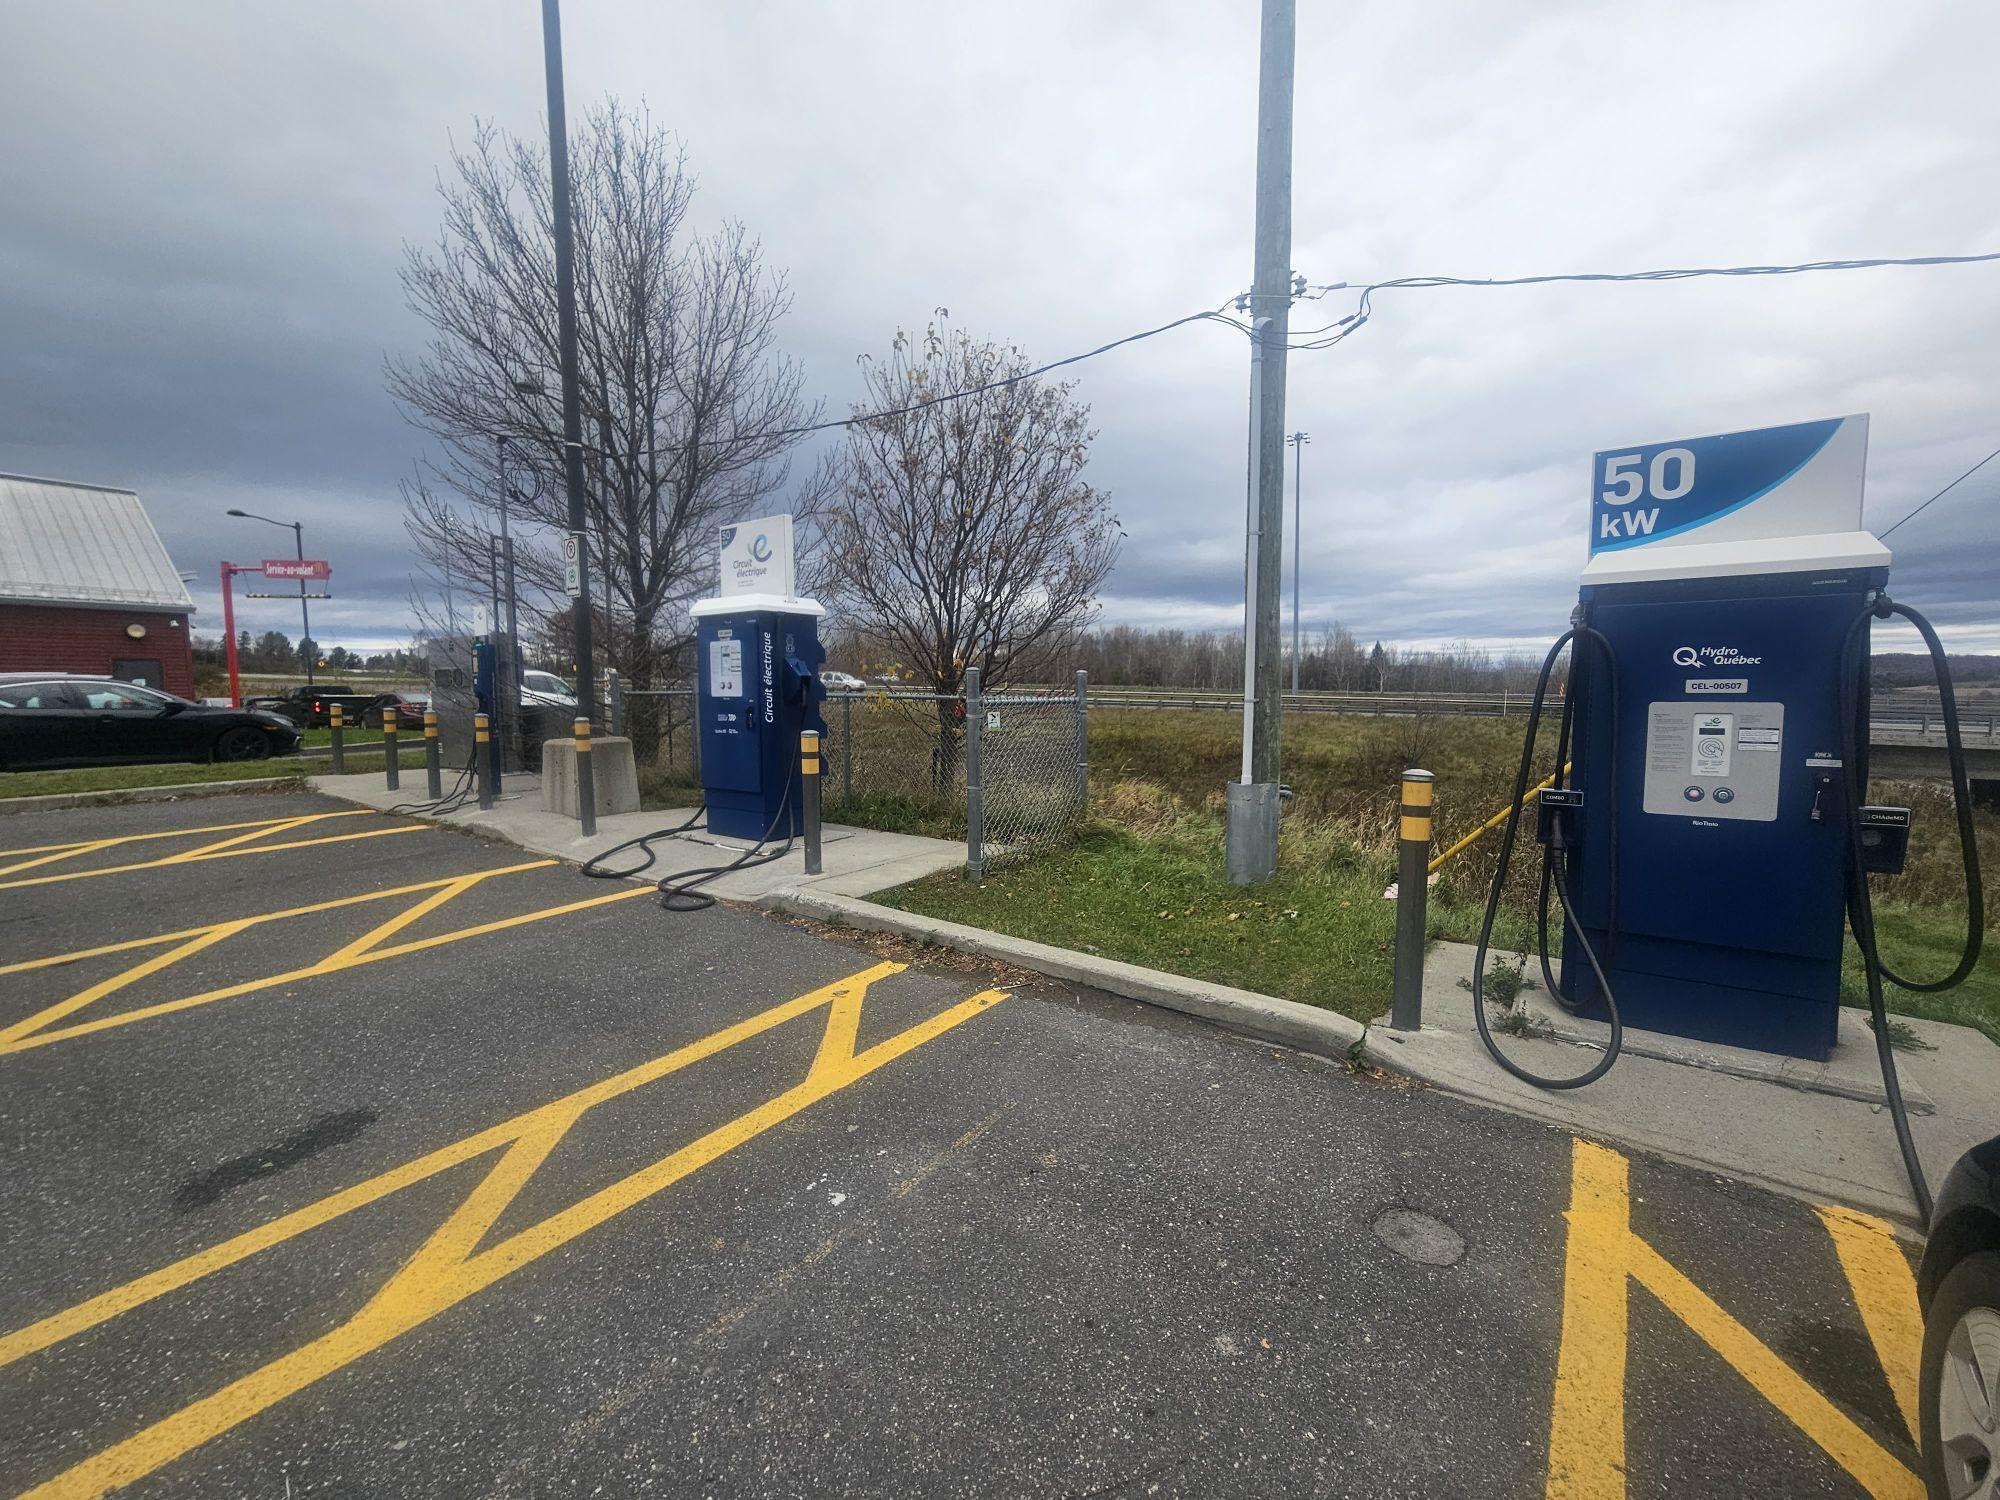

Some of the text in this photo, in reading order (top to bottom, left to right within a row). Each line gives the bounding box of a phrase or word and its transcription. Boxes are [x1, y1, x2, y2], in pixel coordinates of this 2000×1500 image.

[1602, 447, 1696, 506] 50
[1600, 507, 1660, 539] kW
[721, 529, 731, 541] 50
[732, 559, 752, 569] Circuit
[736, 567, 767, 578] électrique
[1700, 646, 1739, 657] Hydro
[1713, 655, 1762, 665] Québec
[763, 631, 774, 723] Circuit électrique
[1691, 682, 1742, 690] CEL-00507
